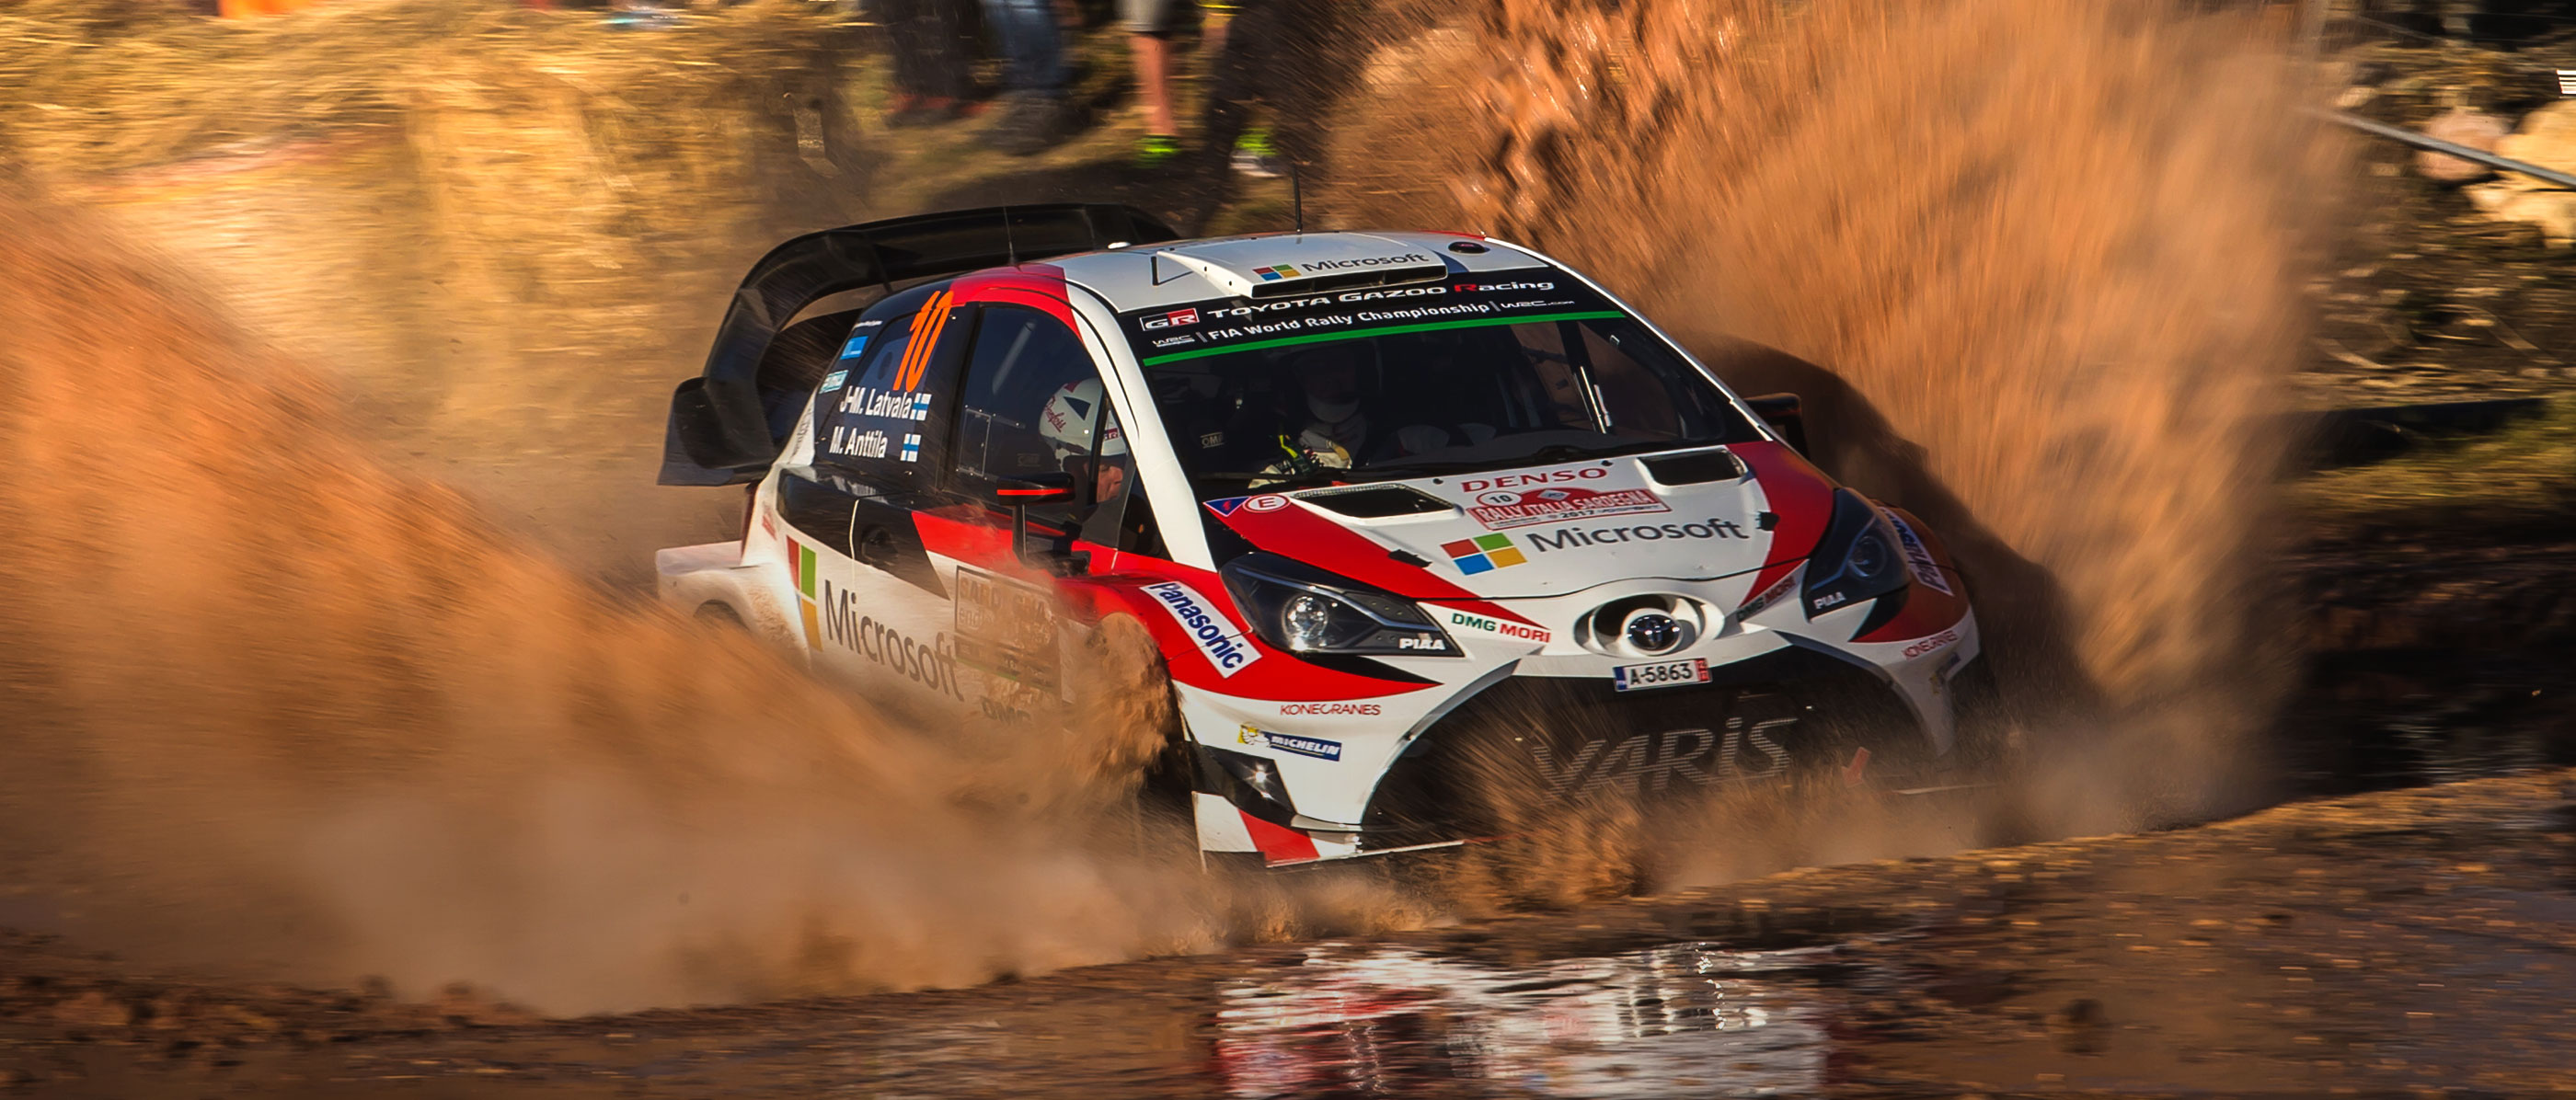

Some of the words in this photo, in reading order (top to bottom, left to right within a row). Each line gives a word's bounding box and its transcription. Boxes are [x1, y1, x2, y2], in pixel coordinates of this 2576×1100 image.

[1302, 253, 1429, 271] Microsoft
[1207, 297, 1331, 318] TOYOTA
[1339, 287, 1447, 303] GAZOO
[1454, 281, 1556, 292] Racing
[1145, 315, 1195, 329] GR
[1208, 328, 1243, 340] FIA
[1245, 318, 1301, 335] World
[1305, 315, 1353, 327] Rally
[1357, 303, 1490, 322] Championship
[892, 291, 954, 393] 10
[865, 388, 913, 420] Latvala
[829, 426, 845, 454] M.
[845, 428, 888, 459] Anttila
[1461, 467, 1607, 493] DENSO
[1474, 505, 1526, 523] RALLY
[1523, 500, 1577, 517] ITALIA
[1571, 489, 1657, 510] SARDEGNA
[1489, 494, 1513, 504] 10
[1526, 519, 1750, 554] Microsoft
[824, 579, 965, 703] Microsoft
[1148, 582, 1244, 669] Panasonic
[1451, 613, 1497, 632] DMG
[1500, 623, 1552, 643] MORI
[1398, 637, 1446, 650] PIAA
[1630, 662, 1693, 685] A-5863
[1280, 704, 1382, 716] KONECRANES
[1271, 735, 1341, 755] MICHELIN
